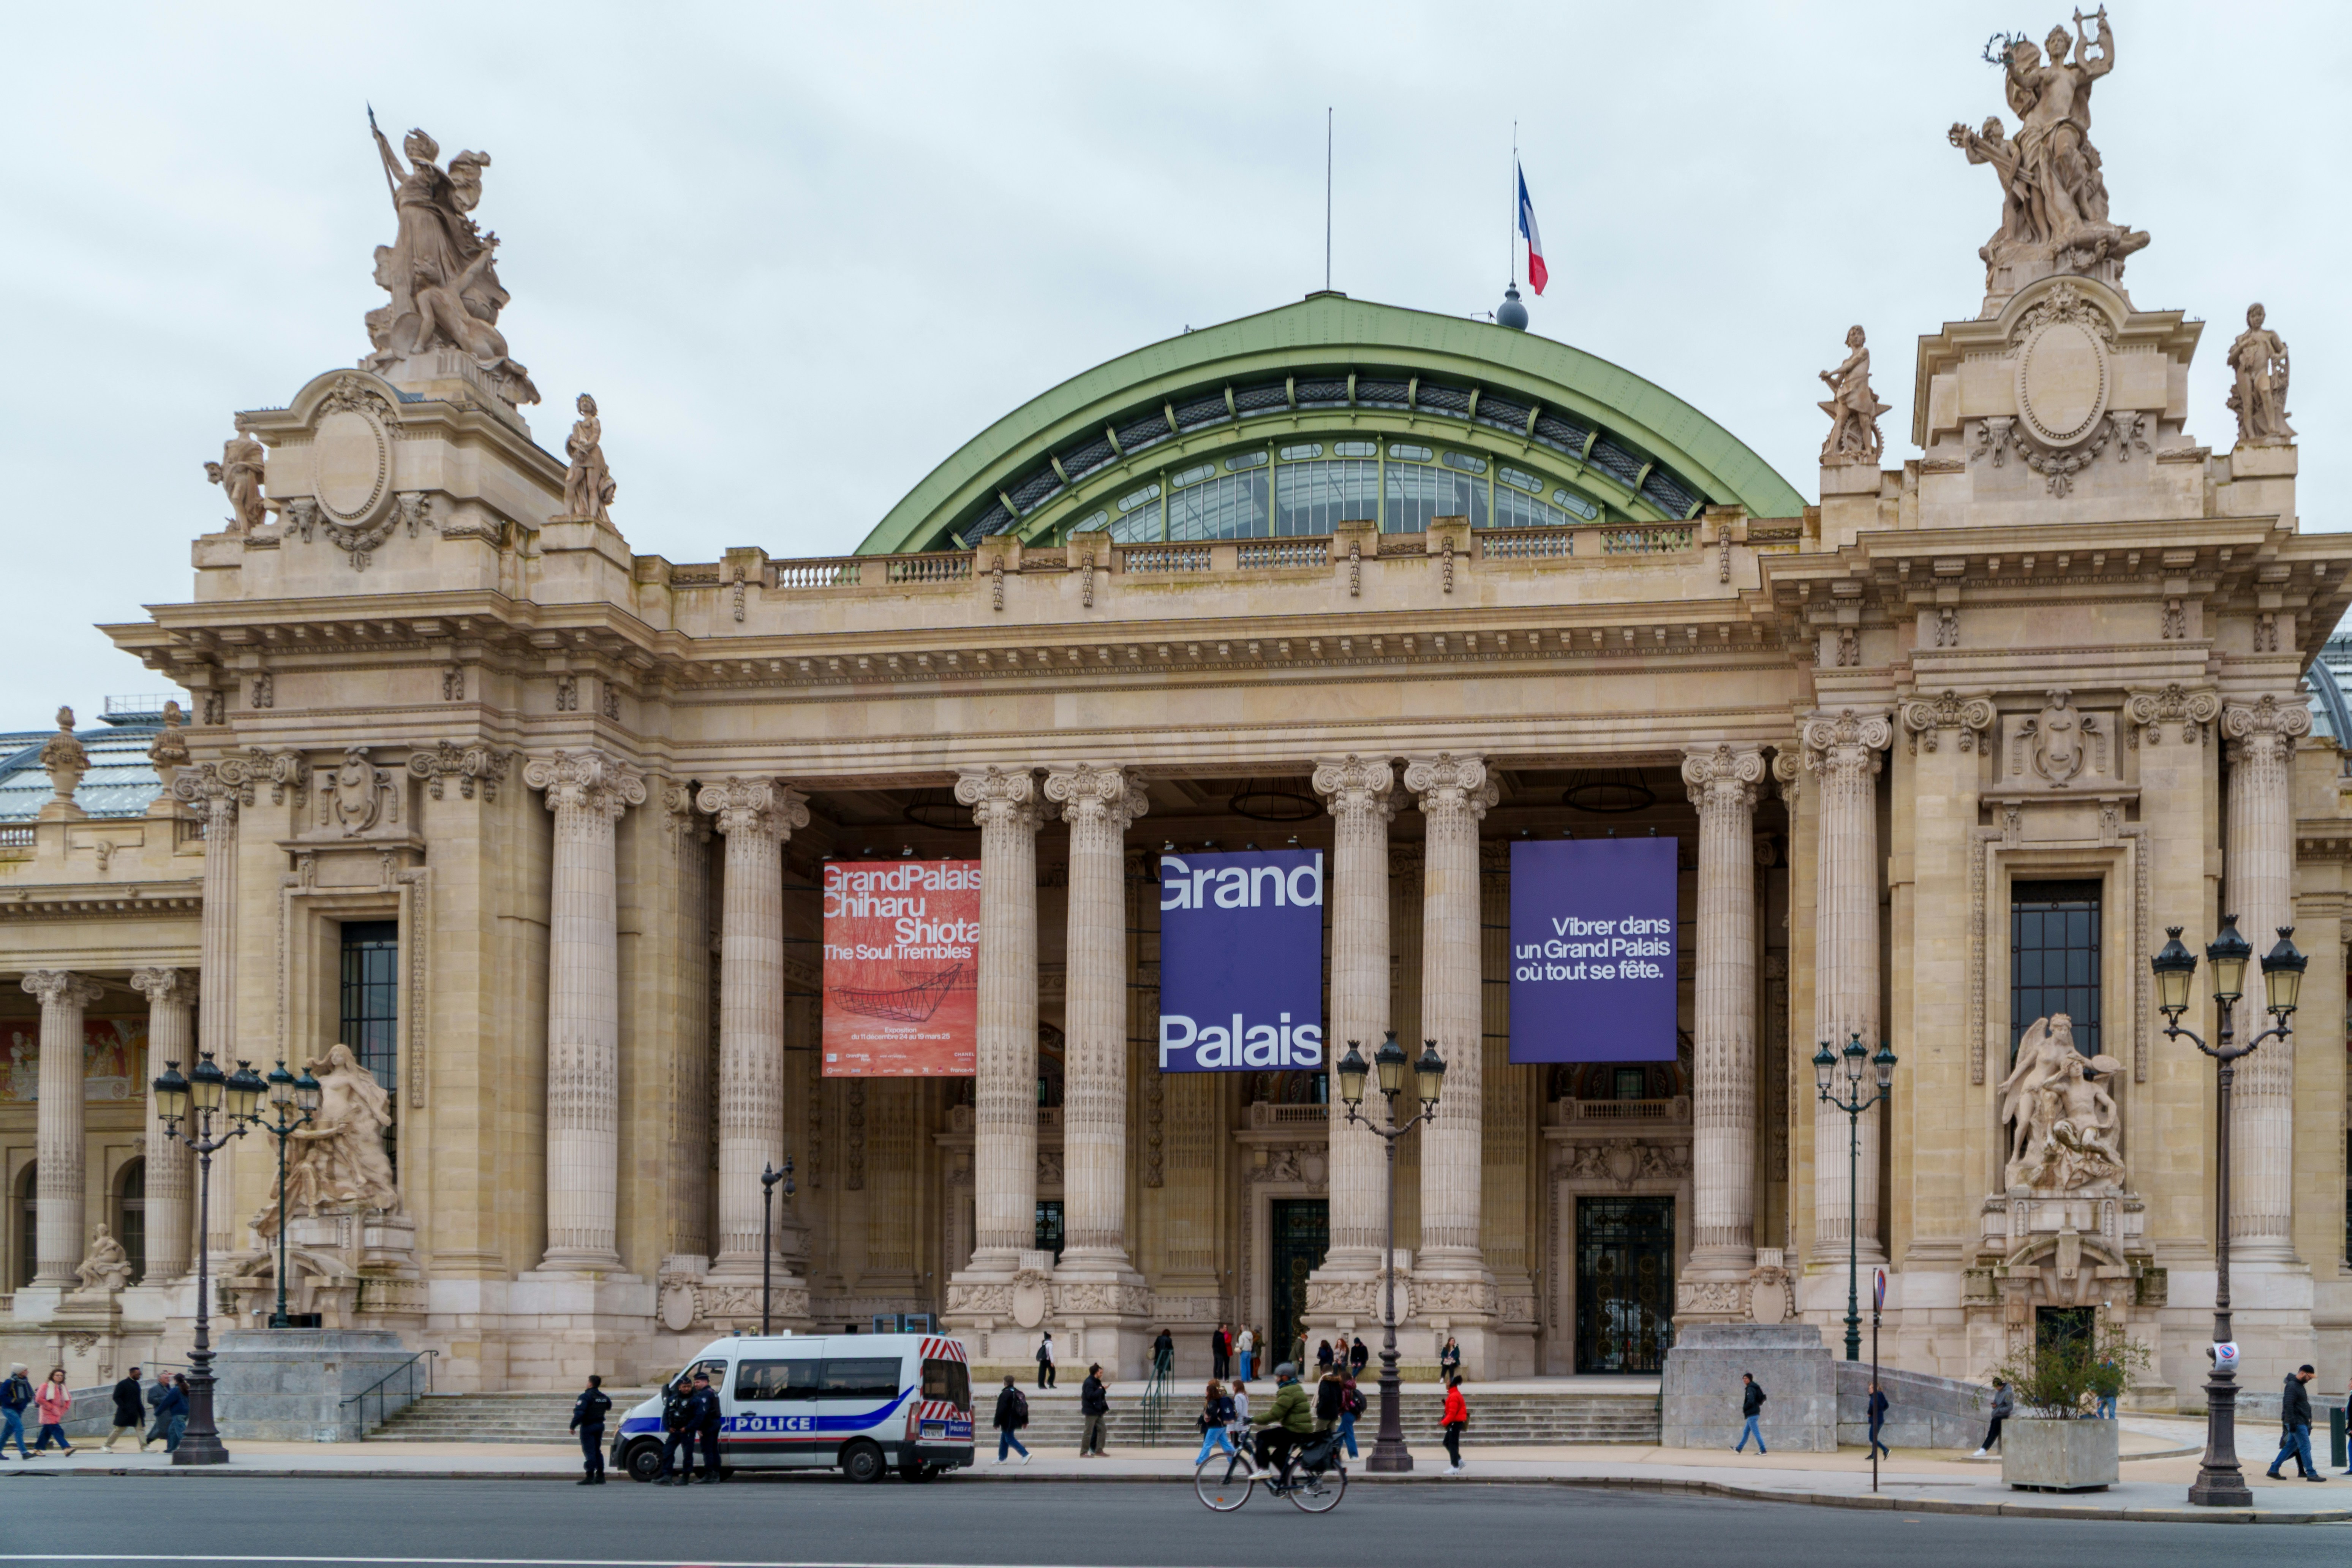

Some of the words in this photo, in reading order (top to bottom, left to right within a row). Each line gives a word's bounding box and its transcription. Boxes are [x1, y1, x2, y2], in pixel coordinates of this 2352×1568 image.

[824, 864, 981, 891] GrandPalais
[1161, 853, 1323, 910] Grand
[824, 892, 925, 918] Chiharu
[895, 917, 980, 944] Shiota
[1552, 917, 1617, 936] Vibrer
[1620, 916, 1670, 935] dans
[824, 945, 853, 960] The
[856, 944, 892, 960] Soul
[1516, 944, 1541, 959] un
[1544, 939, 1608, 959] Grand
[1612, 937, 1671, 957] Palais
[1516, 962, 1543, 982] où
[1545, 962, 1587, 982] tout
[1590, 964, 1615, 980] se
[1619, 960, 1664, 979] fête.
[1159, 1012, 1322, 1068] Palais
[735, 1418, 810, 1430] POLICE
